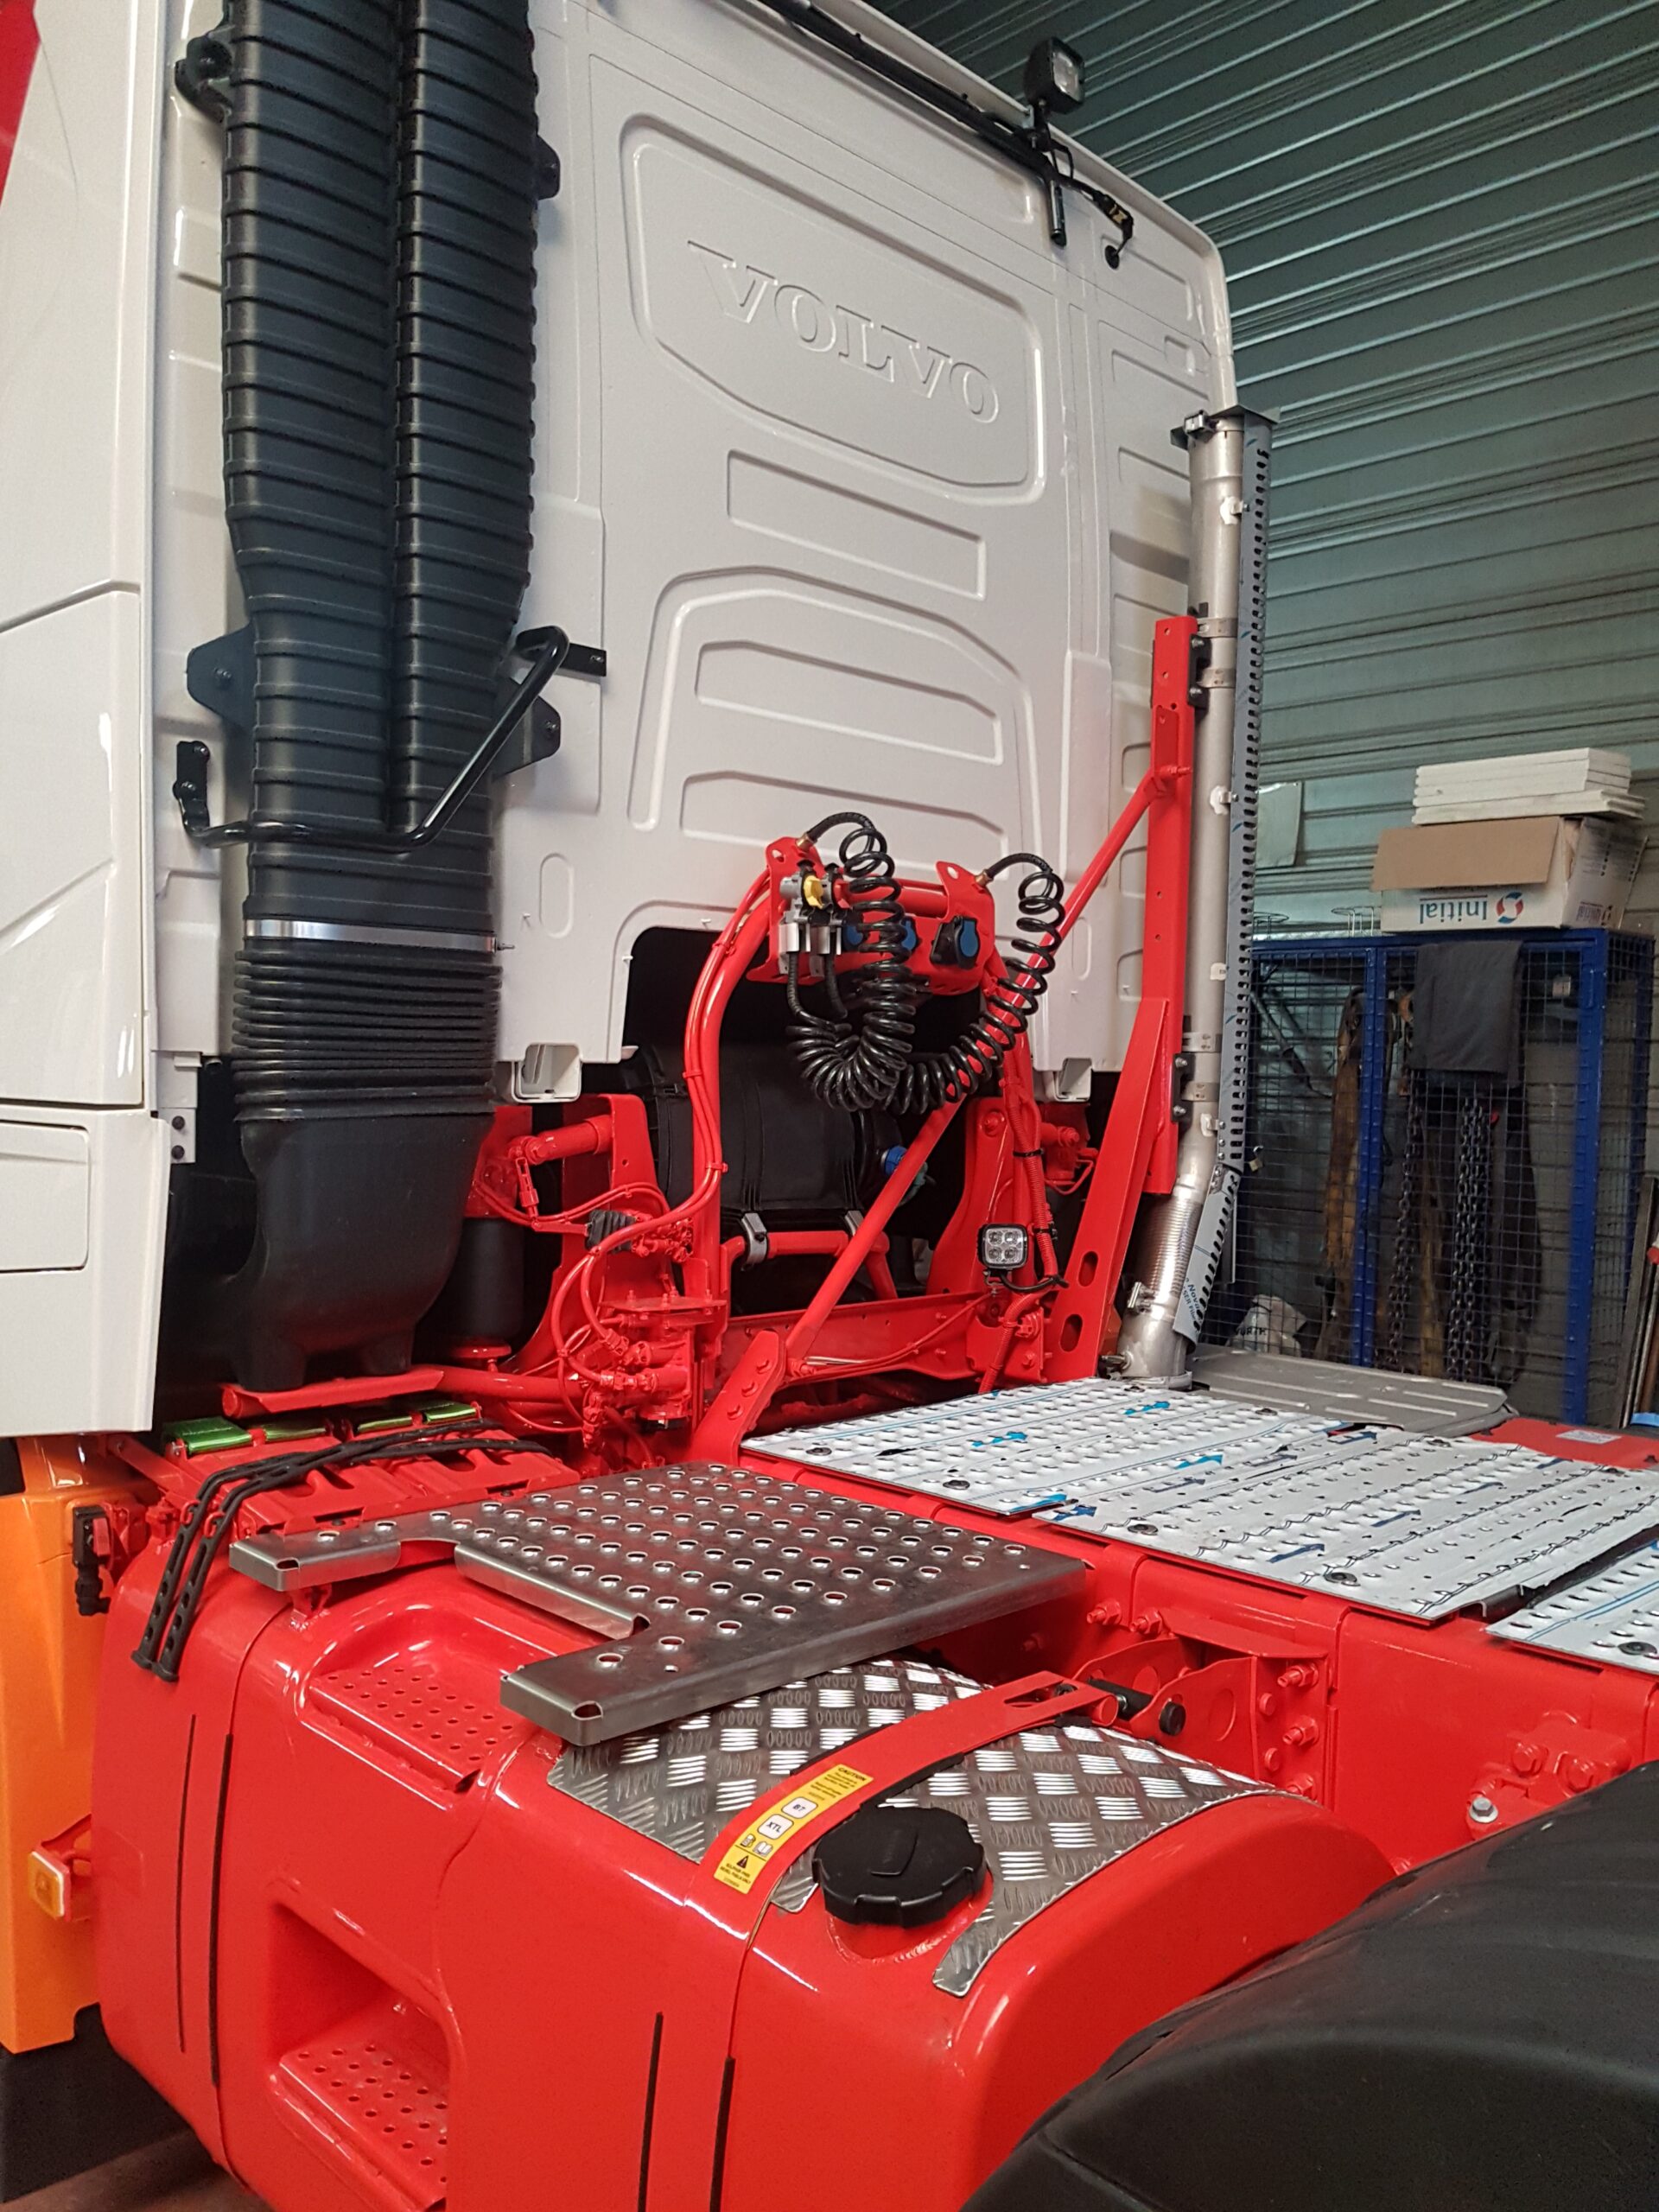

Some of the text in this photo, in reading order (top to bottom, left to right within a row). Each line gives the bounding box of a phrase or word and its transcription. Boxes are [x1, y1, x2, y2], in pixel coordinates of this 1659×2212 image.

[688, 239, 999, 423] VOLVO
[1419, 900, 1487, 924] Initial
[766, 1821, 782, 1833] XTL
